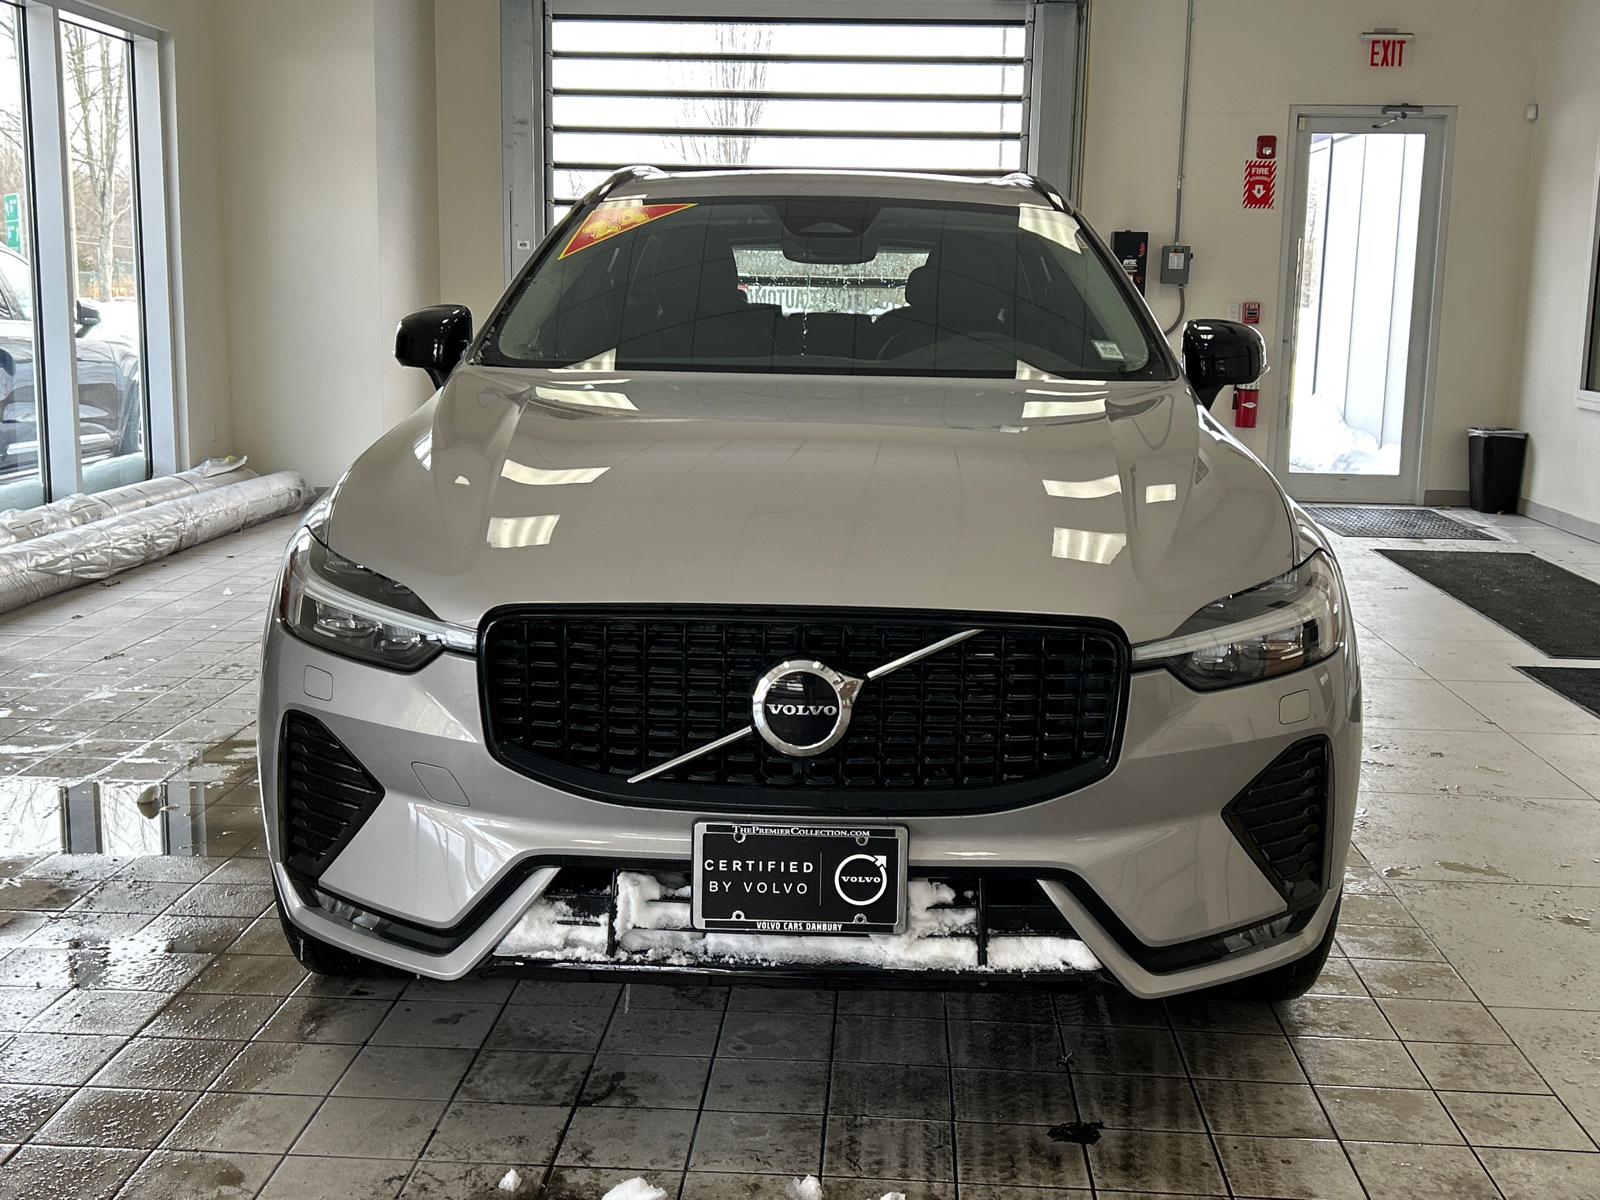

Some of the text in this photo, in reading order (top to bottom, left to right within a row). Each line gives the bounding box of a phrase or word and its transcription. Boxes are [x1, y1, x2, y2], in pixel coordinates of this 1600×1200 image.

[1370, 40, 1406, 66] EXIT
[1251, 167, 1270, 175] FIRE
[766, 704, 837, 716] VOLVO
[704, 859, 814, 873] CERTIFIED
[709, 881, 808, 894] BY VOLVO
[757, 922, 843, 931] VOLVO CARS DANBURY
